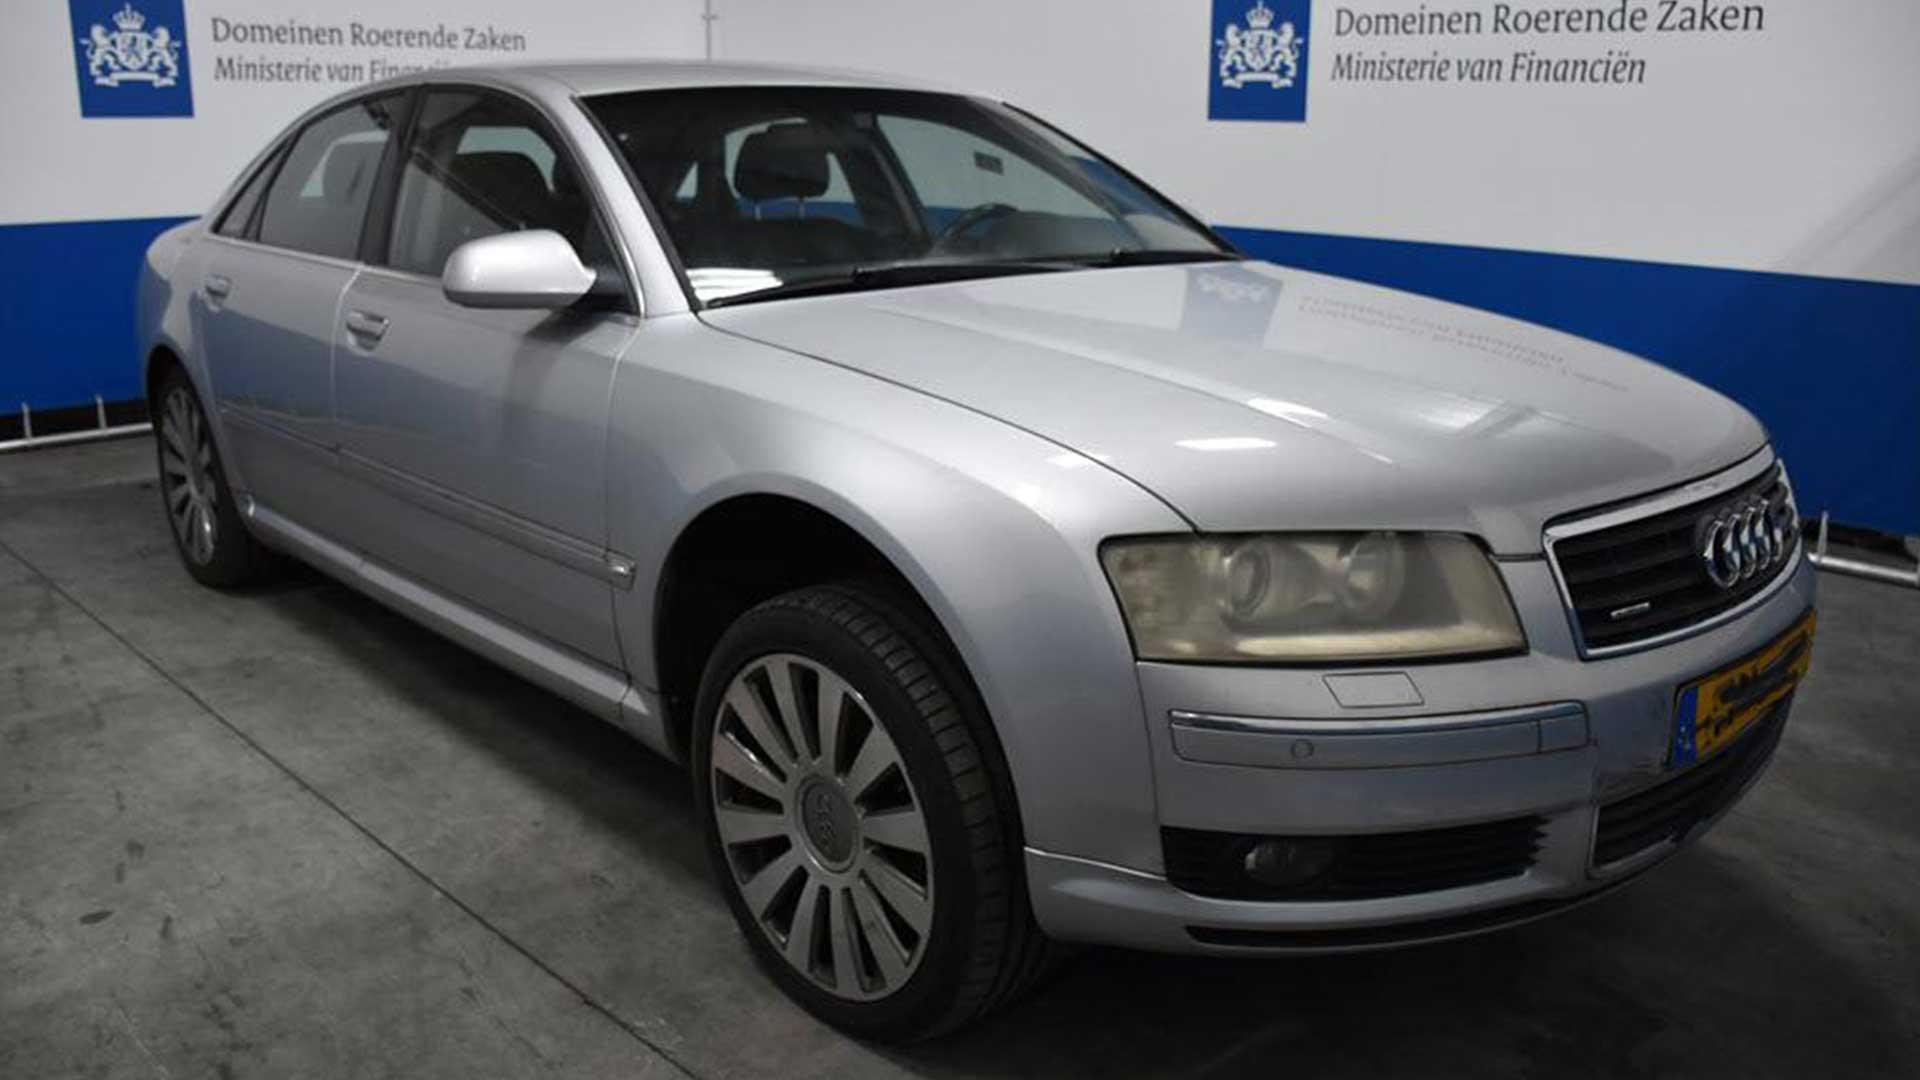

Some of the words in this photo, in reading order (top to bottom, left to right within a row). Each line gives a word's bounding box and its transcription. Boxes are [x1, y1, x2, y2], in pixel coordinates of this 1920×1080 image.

[211, 17, 344, 46] Domeinen
[350, 22, 459, 48] Roerende
[463, 26, 527, 51] Zaken
[1335, 4, 1482, 36] Domeinen
[1492, 0, 1648, 34] Roerende
[1656, 0, 1765, 31] Zaken
[214, 55, 323, 81] Ministerie
[326, 63, 364, 82] van
[1331, 50, 1451, 82] Ministerie
[1457, 58, 1503, 82] van
[1510, 49, 1647, 83] Financiën
